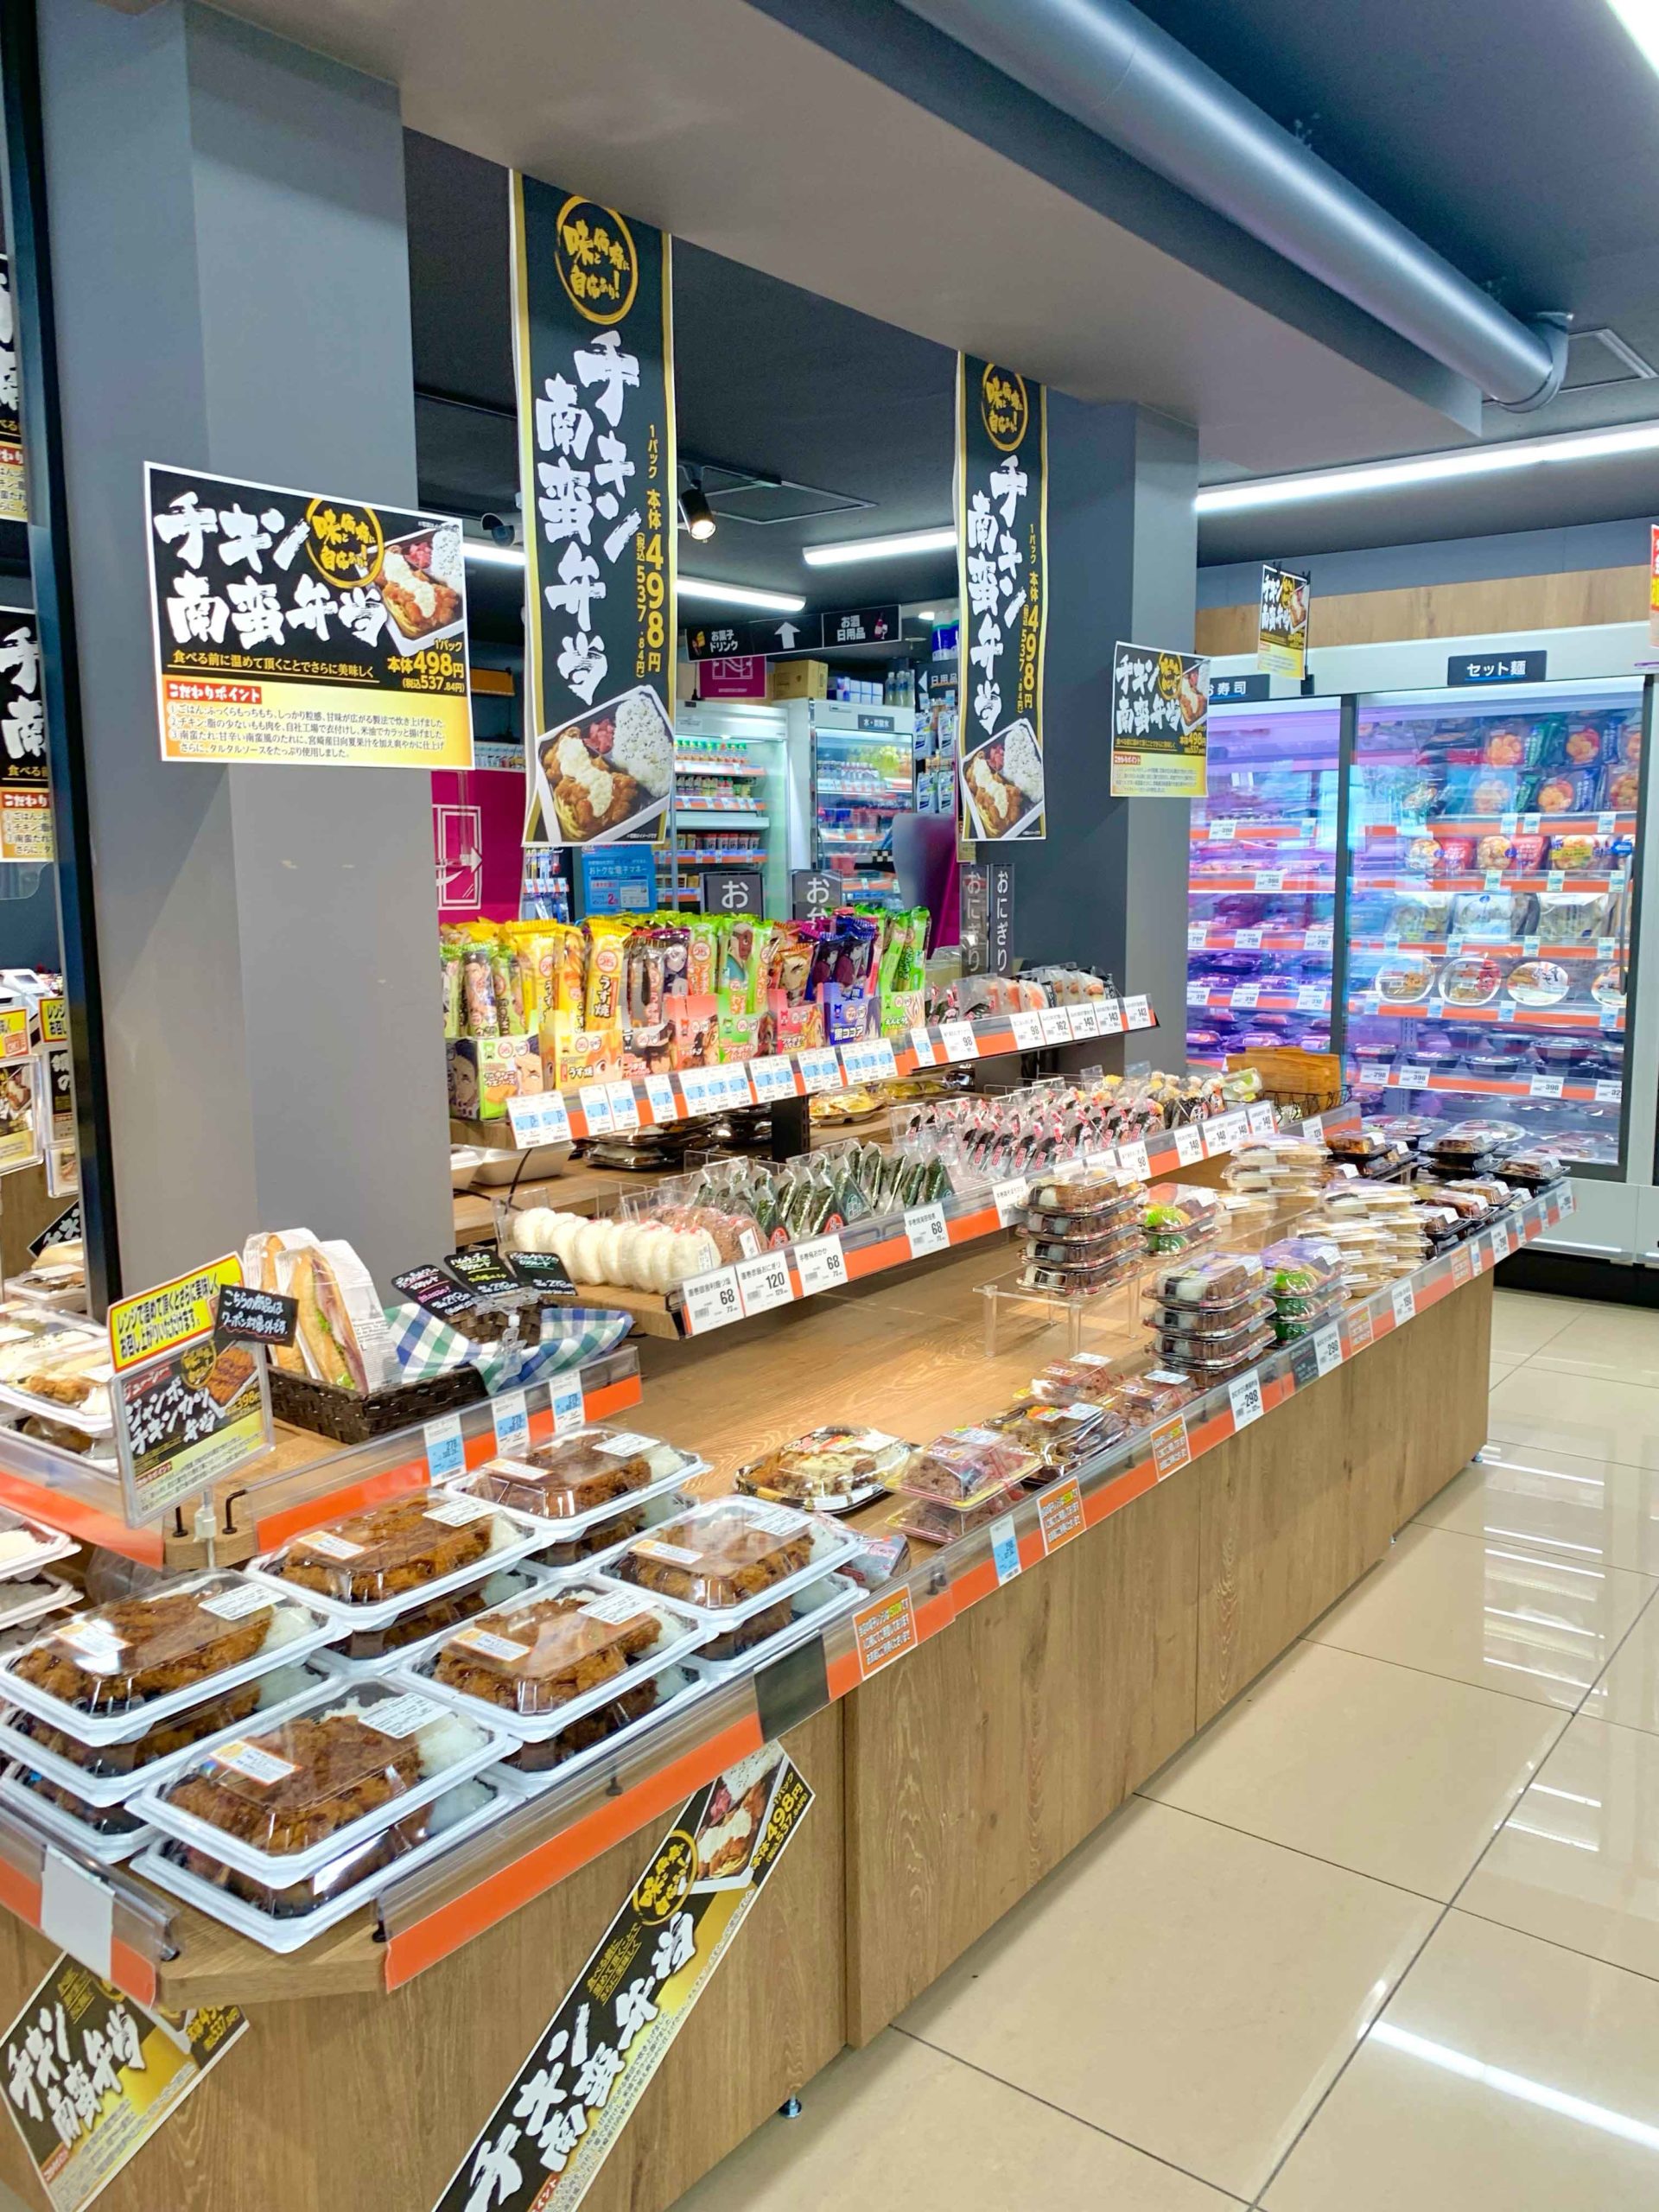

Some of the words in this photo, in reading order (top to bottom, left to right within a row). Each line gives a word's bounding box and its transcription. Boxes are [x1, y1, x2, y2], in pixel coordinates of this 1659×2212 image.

[574, 330, 642, 563] チキン
[153, 491, 311, 574] チキン
[535, 372, 607, 706] 南蛮弁当
[989, 454, 1027, 629] チキン
[166, 569, 389, 650] 南蛮弁当
[841, 614, 861, 627] お酒
[967, 490, 1004, 735] 南蛮弁当
[836, 626, 867, 641] 日用品
[435, 639, 463, 652] 1パック
[709, 639, 739, 653] ドリンク
[173, 649, 374, 679] 食べる前に温めて頂くことでさらに美味しく
[387, 651, 464, 679] 本体498円
[1465, 659, 1528, 679] セット麺
[168, 683, 261, 703] こだわりポイント
[995, 870, 1009, 970] おにぎり
[834, 1025, 864, 1041] 黒ココア
[931, 1220, 943, 1235] 68
[826, 1255, 841, 1270] 68
[766, 1271, 785, 1289] 120
[224, 1289, 283, 1315] こちらの商品は
[719, 1287, 735, 1306] 68
[1327, 1339, 1339, 1356] 298
[1244, 1389, 1259, 1408] 298
[750, 1784, 804, 1871] 本体498円
[537, 1910, 696, 2173] 南蛮弁当
[47, 2003, 146, 2150] 南蛮弁当
